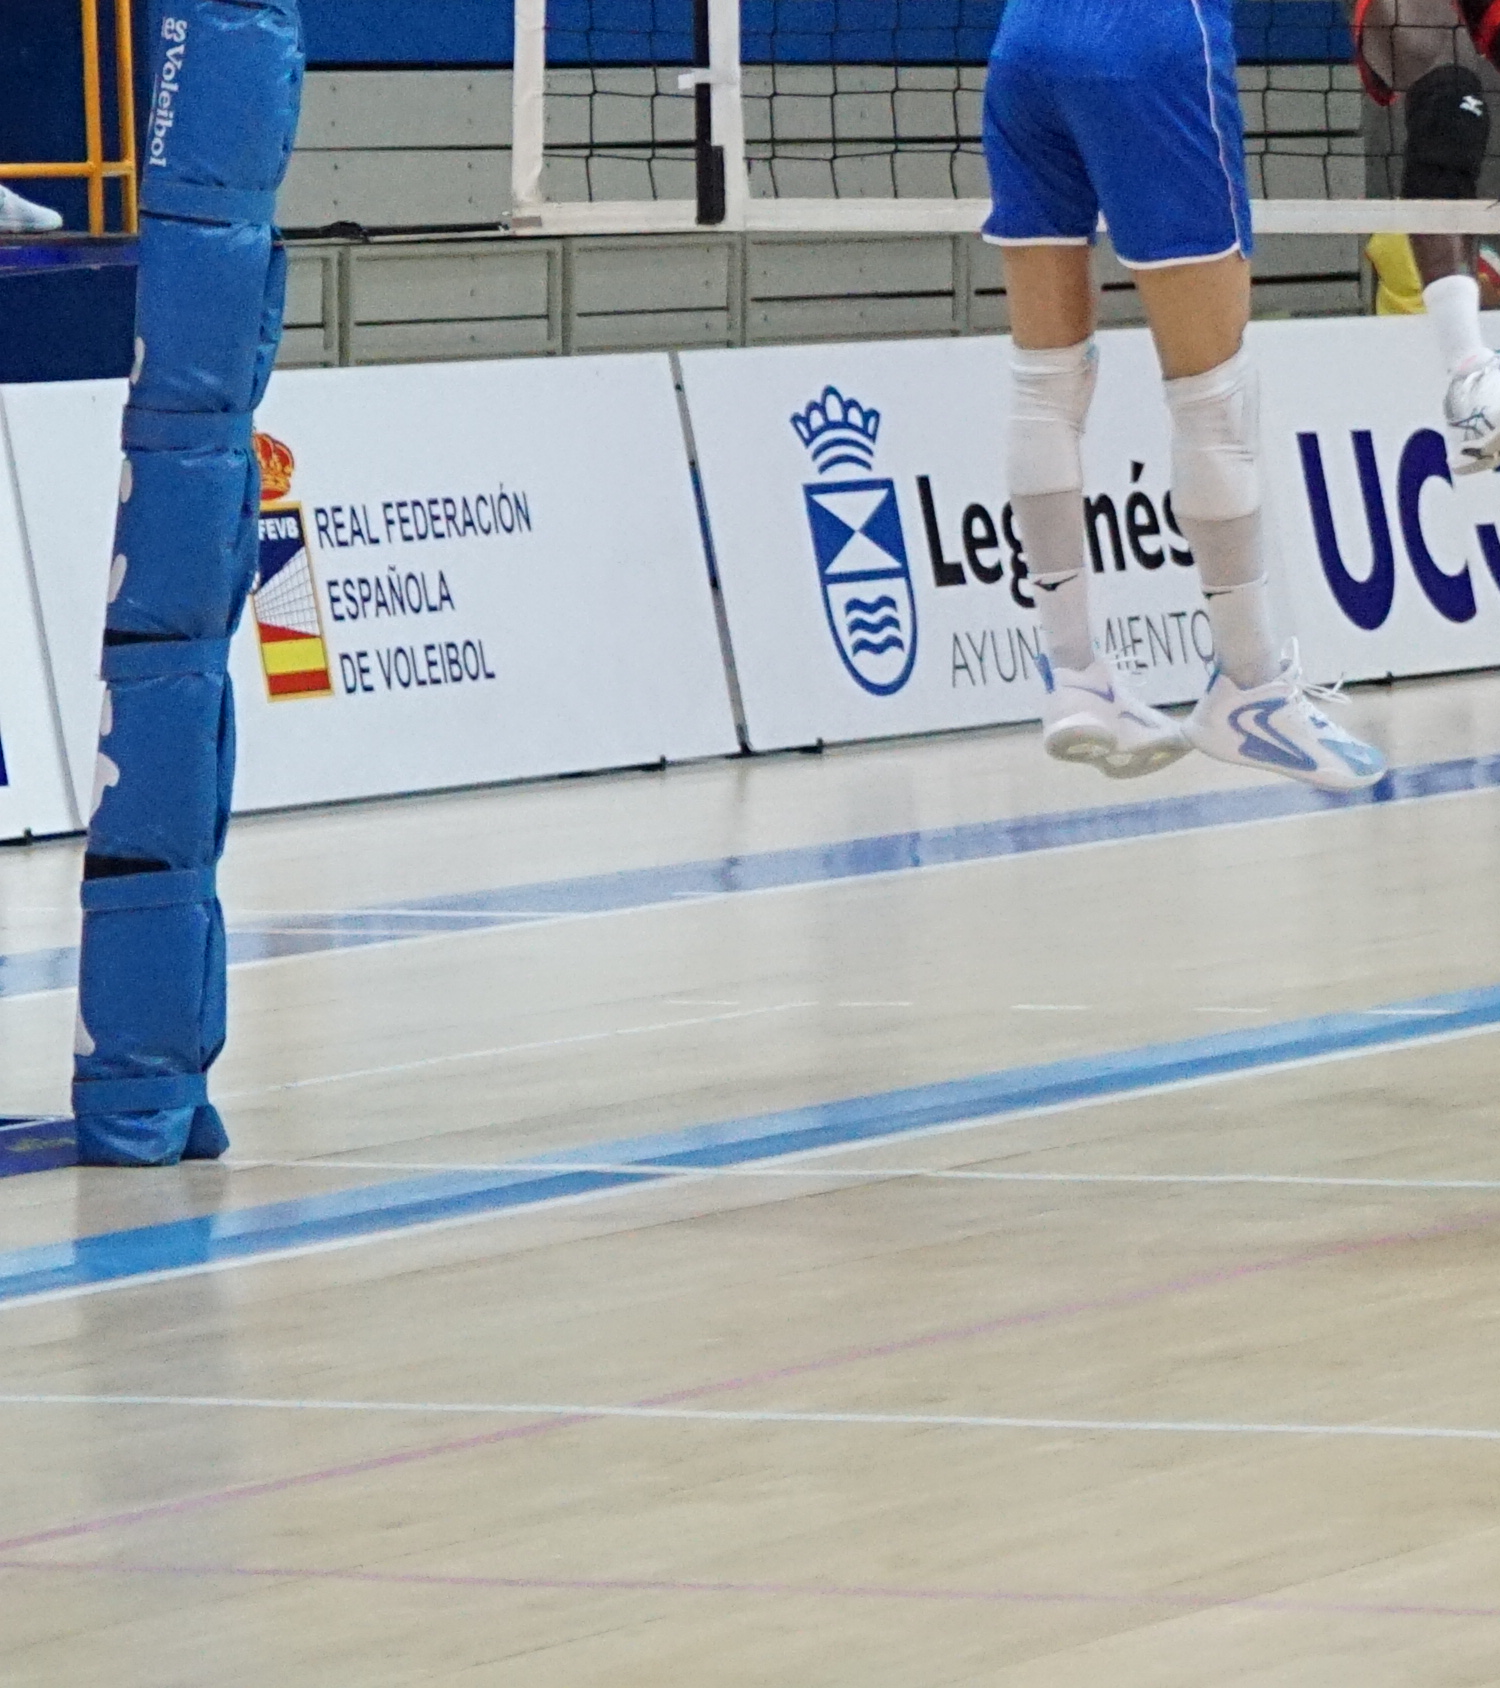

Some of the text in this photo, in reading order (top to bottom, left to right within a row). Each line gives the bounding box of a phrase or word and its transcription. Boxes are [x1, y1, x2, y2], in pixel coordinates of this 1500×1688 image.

[149, 43, 186, 168] Voleibol
[313, 482, 533, 550] REAL FEDERACIÓN
[326, 564, 456, 622] ESPAÑOLA
[338, 638, 496, 695] DE VOLEIBOL
